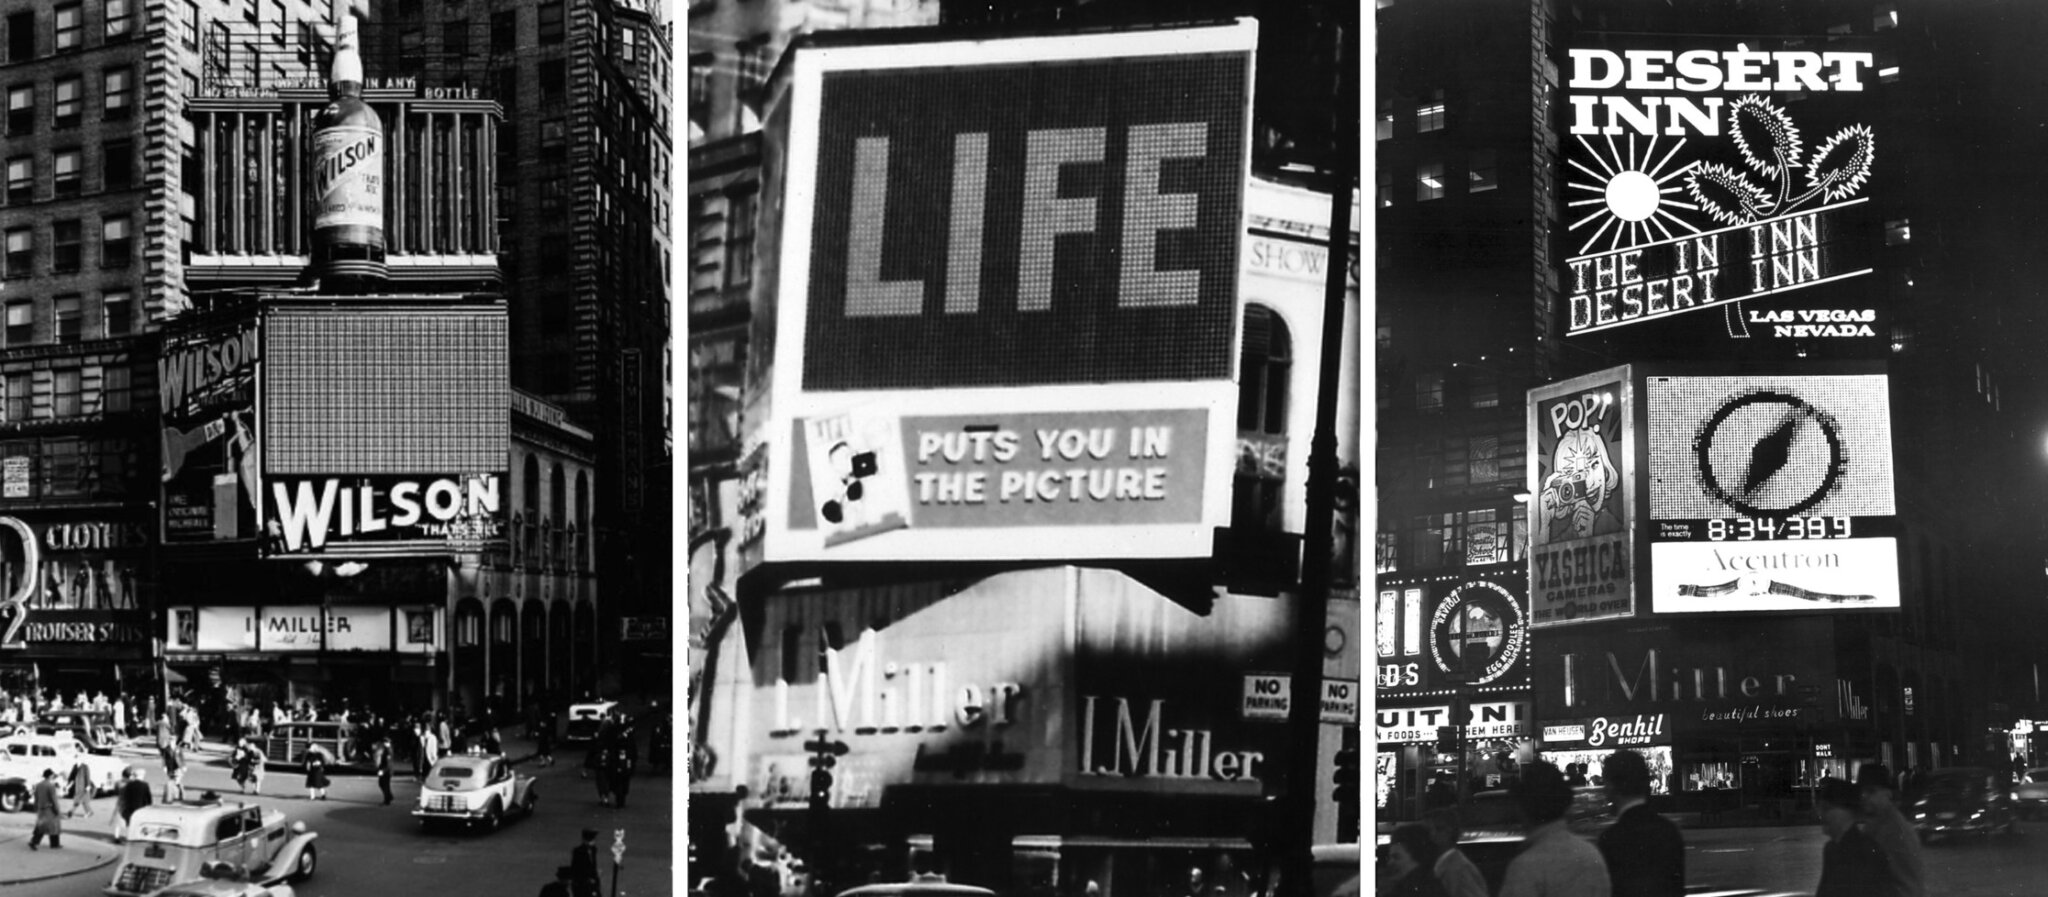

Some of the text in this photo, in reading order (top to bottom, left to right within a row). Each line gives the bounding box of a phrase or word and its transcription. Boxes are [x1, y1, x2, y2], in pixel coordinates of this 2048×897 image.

[365, 77, 379, 89] IN
[424, 87, 480, 99] BOTTLE
[1569, 95, 1724, 136] INN
[845, 122, 1208, 317] LIFE
[1569, 213, 1818, 294] THE IN INN
[1569, 246, 1820, 331] DESERT INN
[1749, 309, 1876, 322] LAS VEGAS
[1773, 324, 1876, 338] NEVADA
[158, 327, 259, 415] WILSON
[917, 426, 1171, 465] PUTS YOU IN
[914, 466, 1167, 506] THE PICTURE
[272, 478, 500, 552] WILSON
[46, 522, 149, 550] CLOTHES
[1535, 540, 1626, 590] YASHICA
[1706, 548, 1841, 571] Accutron
[1546, 582, 1616, 602] CAMERAS
[26, 622, 96, 642] TROUSER
[268, 616, 352, 633] MILLER
[1254, 679, 1281, 695] NO
[1606, 648, 1796, 703] Miller
[1327, 684, 1349, 700] NO
[1246, 697, 1288, 711] PARKING
[1702, 704, 1798, 724] beautiful shoes
[1544, 727, 1557, 737] VAN
[1588, 713, 1664, 747] Benhil
